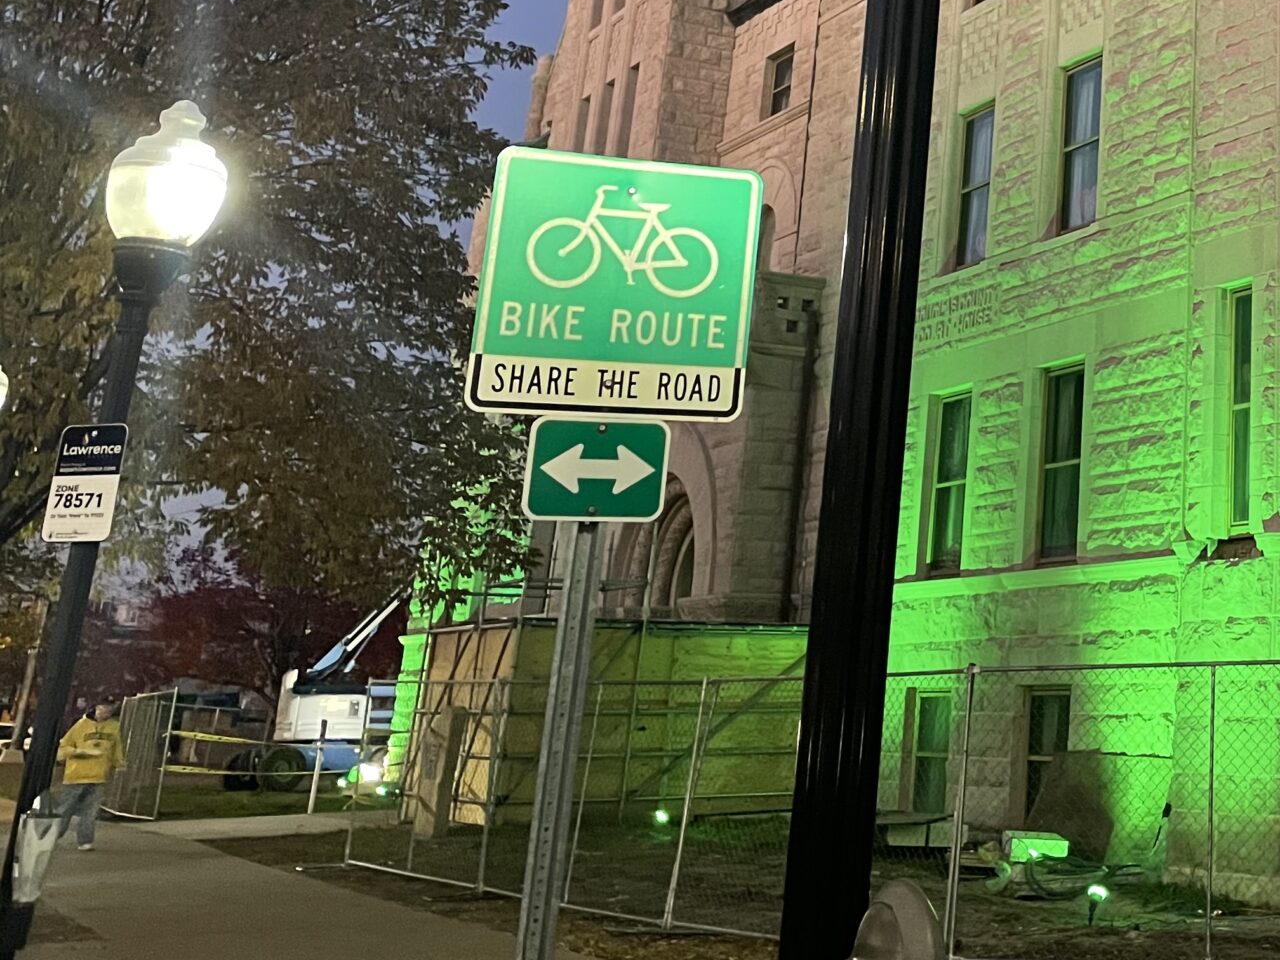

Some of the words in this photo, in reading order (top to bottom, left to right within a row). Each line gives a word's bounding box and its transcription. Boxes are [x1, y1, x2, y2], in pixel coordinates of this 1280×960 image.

[499, 301, 585, 341] BIKE
[610, 309, 727, 349] ROUTE
[491, 363, 578, 396] SHARE
[597, 369, 640, 399] THE
[657, 372, 722, 402] ROAD
[63, 443, 122, 456] Lawrence
[56, 485, 80, 493] ZONE
[53, 493, 103, 508] 78571
